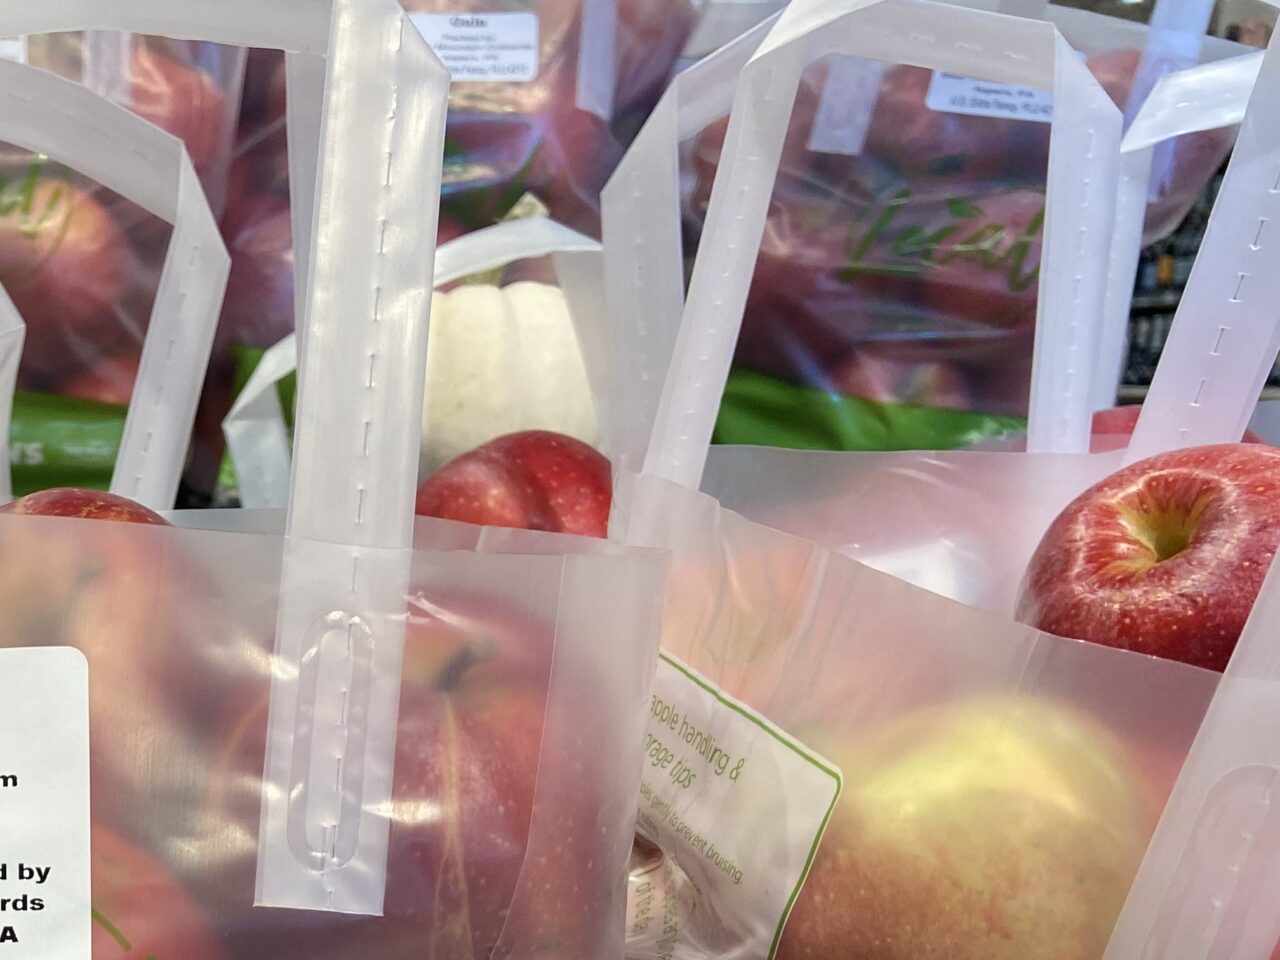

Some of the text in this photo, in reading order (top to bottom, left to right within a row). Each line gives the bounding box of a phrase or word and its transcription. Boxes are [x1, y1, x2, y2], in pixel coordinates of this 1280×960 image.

[644, 734, 697, 789] rage tips
[678, 715, 730, 776] handling
[729, 758, 745, 783] &
[675, 821, 708, 853] prevent
[18, 863, 51, 884] by
